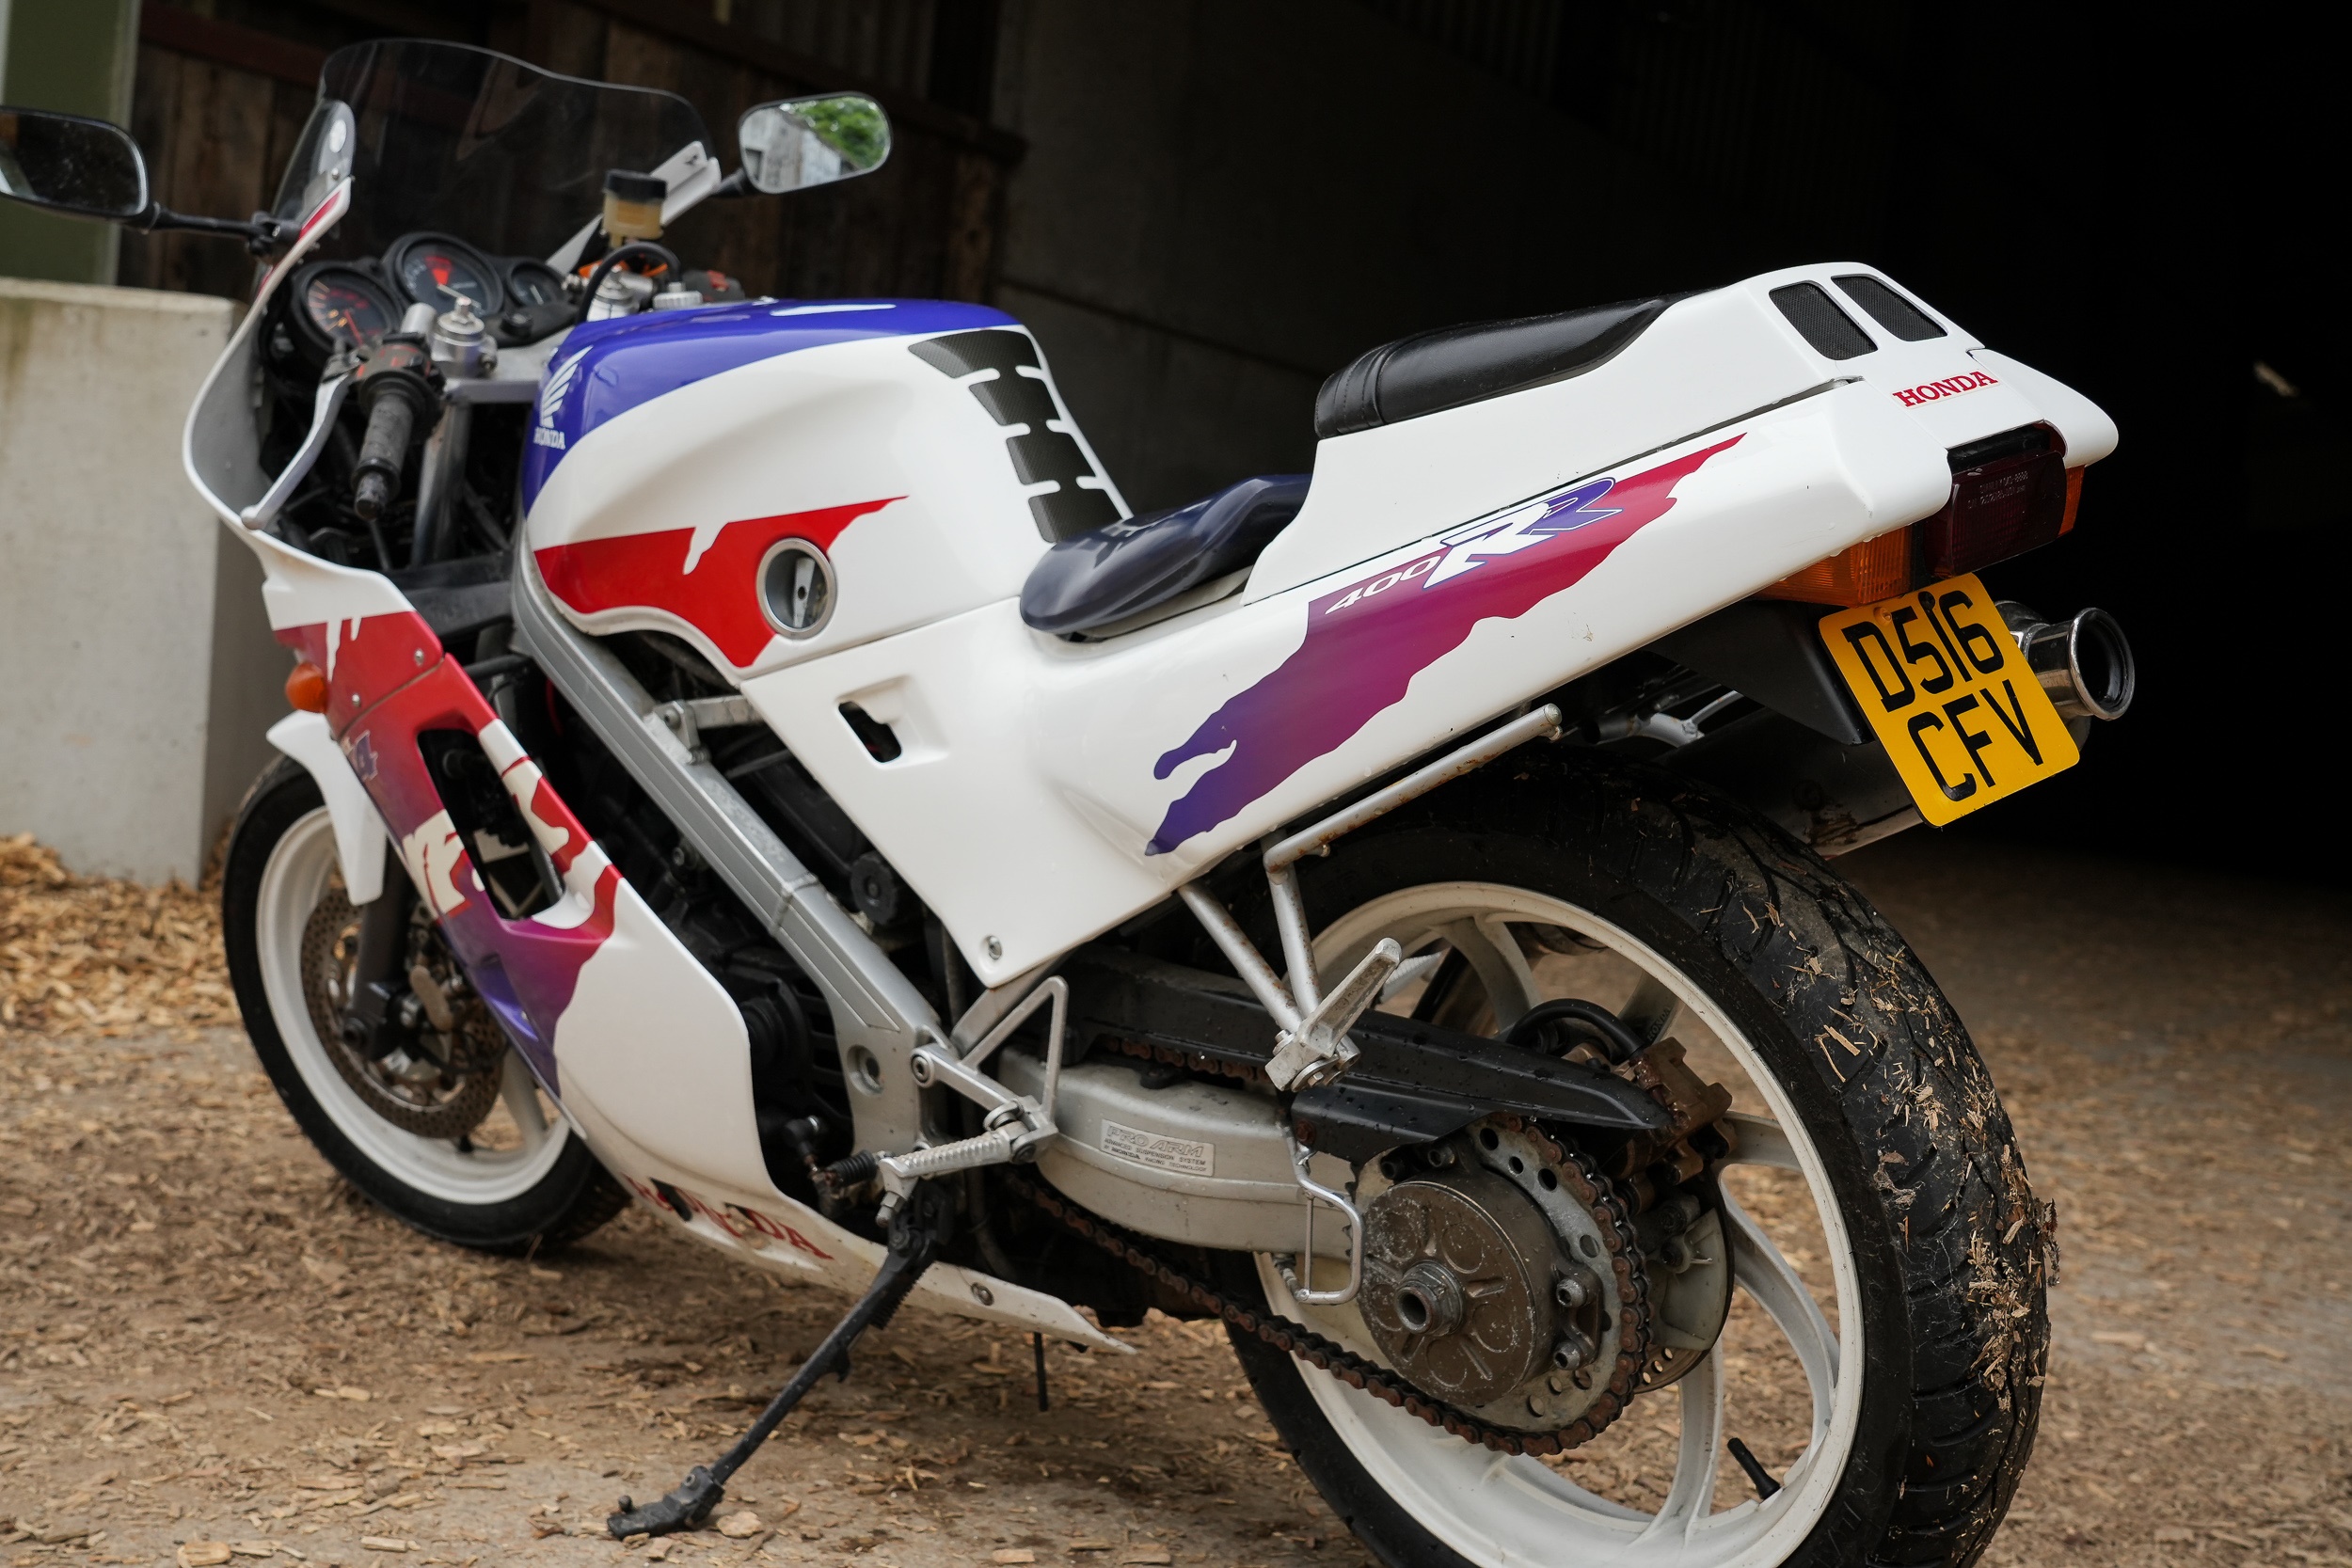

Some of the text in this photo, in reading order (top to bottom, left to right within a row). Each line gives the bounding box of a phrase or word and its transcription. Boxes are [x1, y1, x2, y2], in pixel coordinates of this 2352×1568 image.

[1893, 371, 1998, 407] HONDA
[533, 426, 565, 450] HONDA
[1840, 591, 2005, 713] D516
[1907, 678, 2044, 801] CFV
[1106, 1125, 1205, 1158] PRO ARM
[1136, 1148, 1175, 1161] SUSPENSION
[1179, 1156, 1207, 1166] SYSTEM
